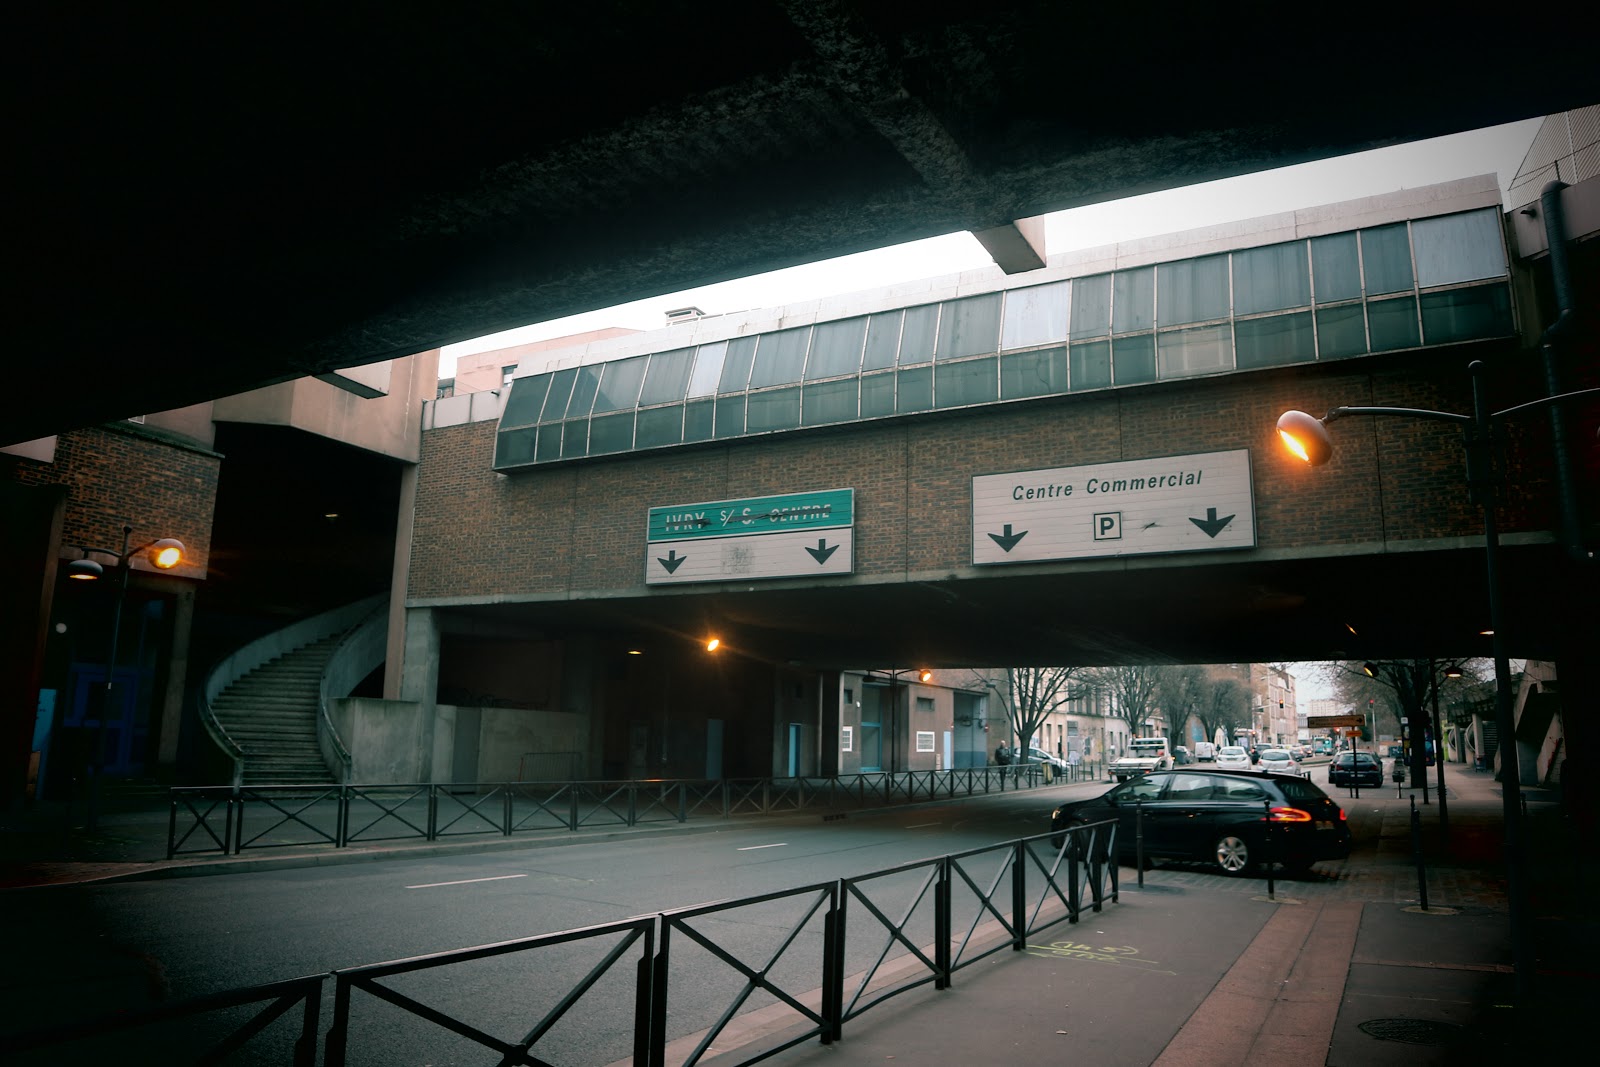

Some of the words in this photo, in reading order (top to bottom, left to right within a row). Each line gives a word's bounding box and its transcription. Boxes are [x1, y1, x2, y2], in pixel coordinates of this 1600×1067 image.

[1012, 483, 1074, 501] Centre
[1086, 470, 1203, 495] Commercial
[665, 512, 706, 531] IVRY
[769, 504, 831, 522] CENTRE
[1100, 517, 1115, 536] P
